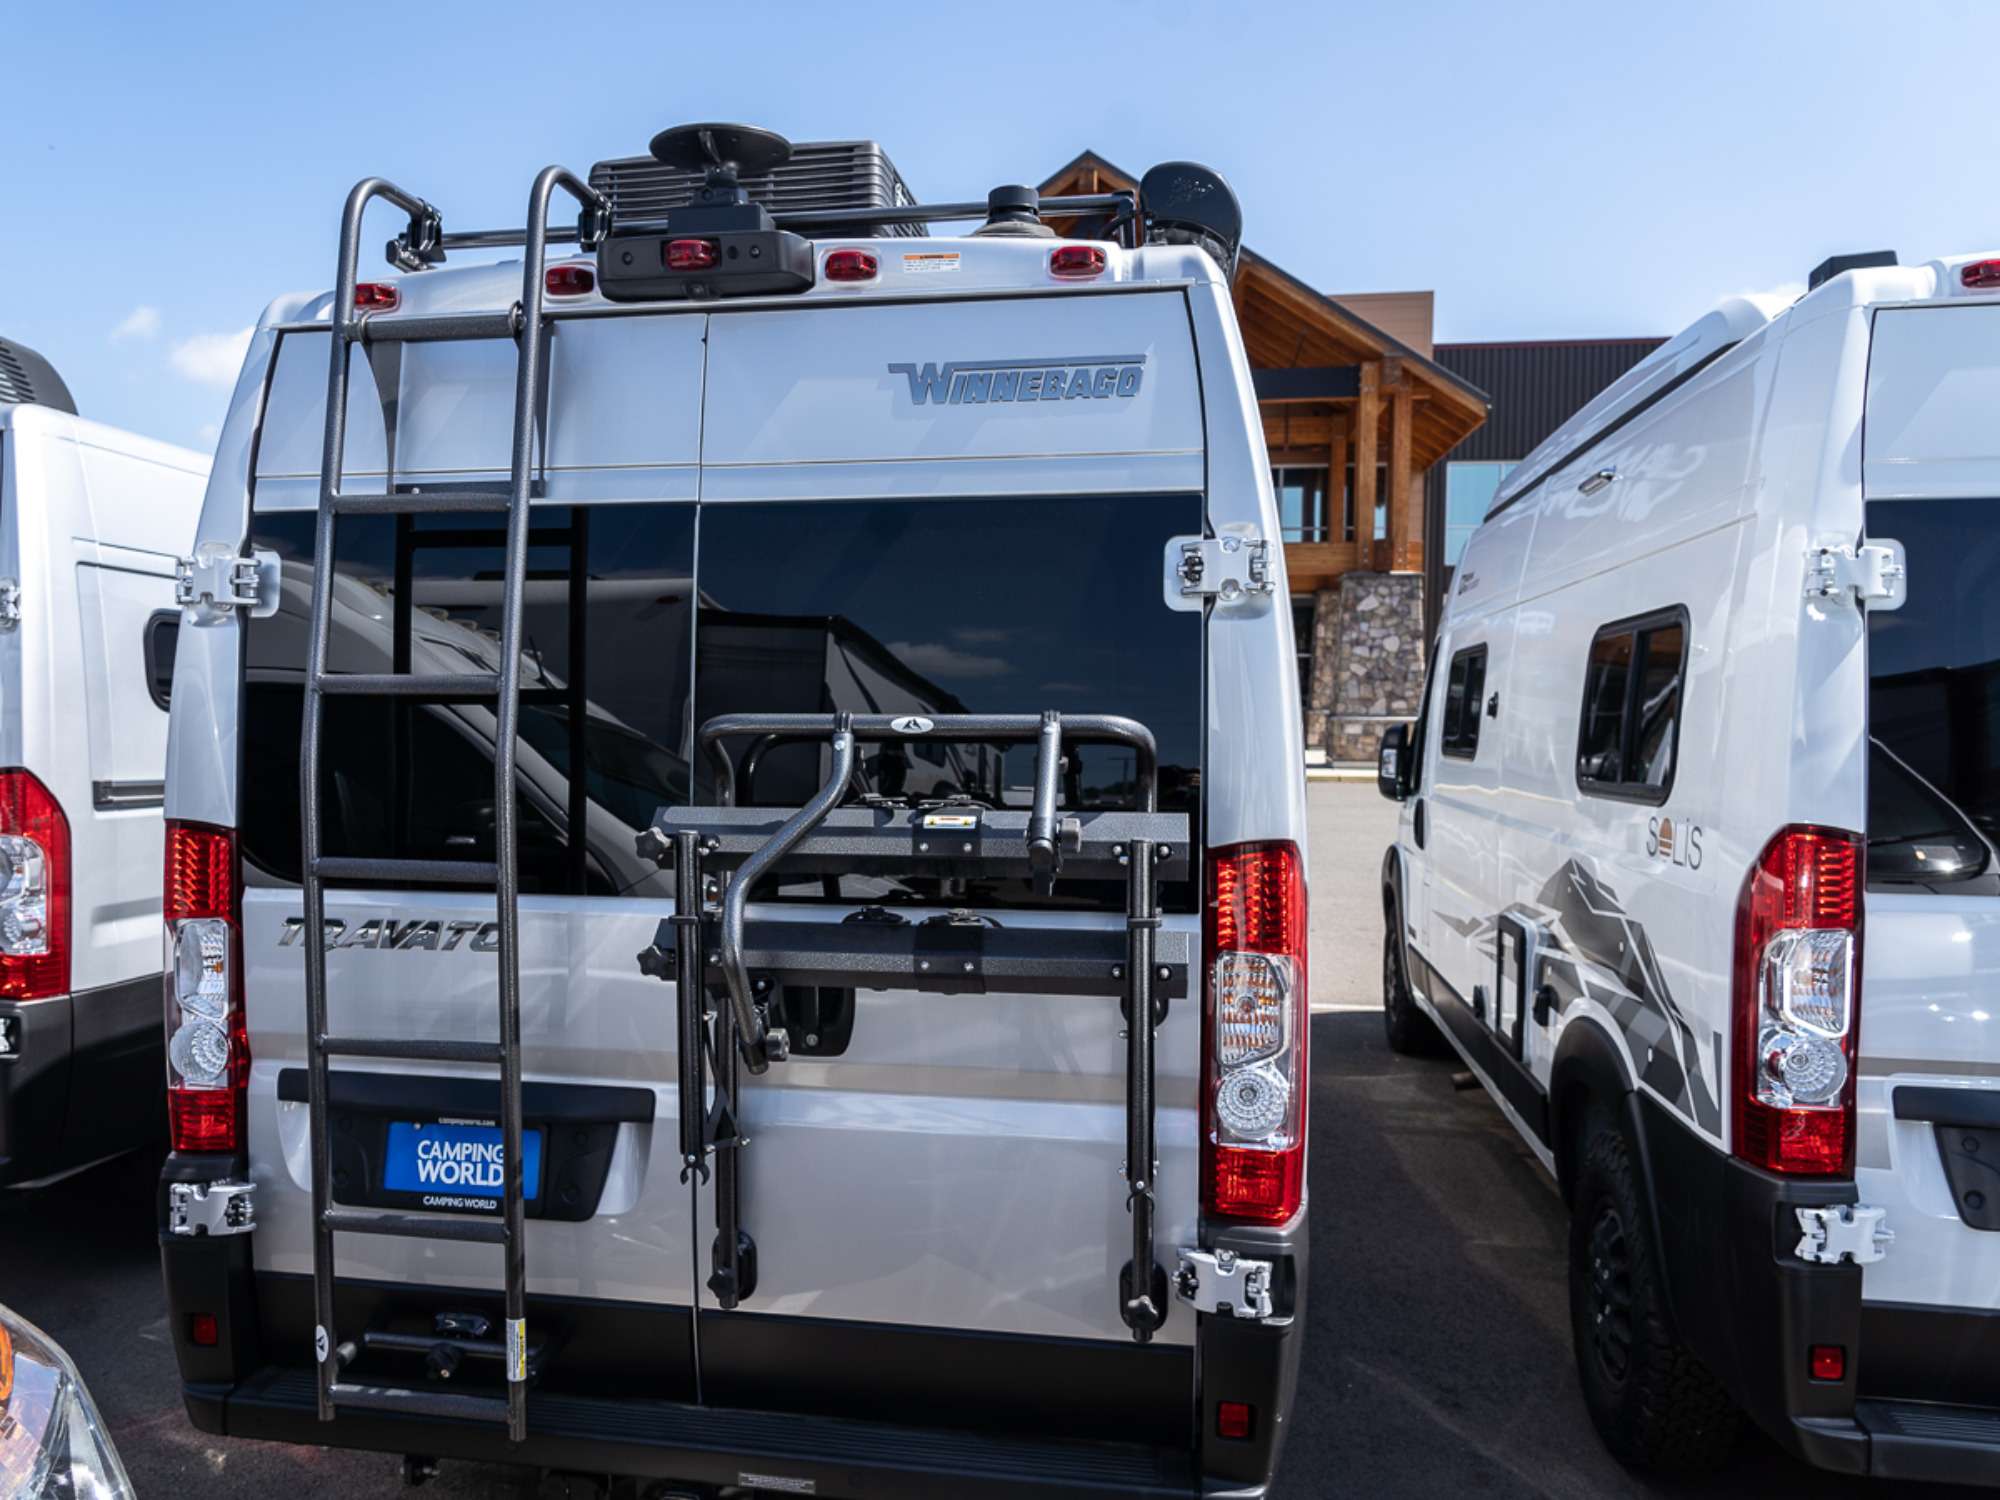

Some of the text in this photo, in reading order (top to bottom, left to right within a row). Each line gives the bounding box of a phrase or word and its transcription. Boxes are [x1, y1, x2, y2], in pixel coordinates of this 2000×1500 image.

[888, 354, 1147, 405] WINNEBAGO
[417, 1140, 504, 1163] CAMPING
[417, 1160, 504, 1187] WORLD
[423, 1196, 497, 1209] CAMPING WORLD
